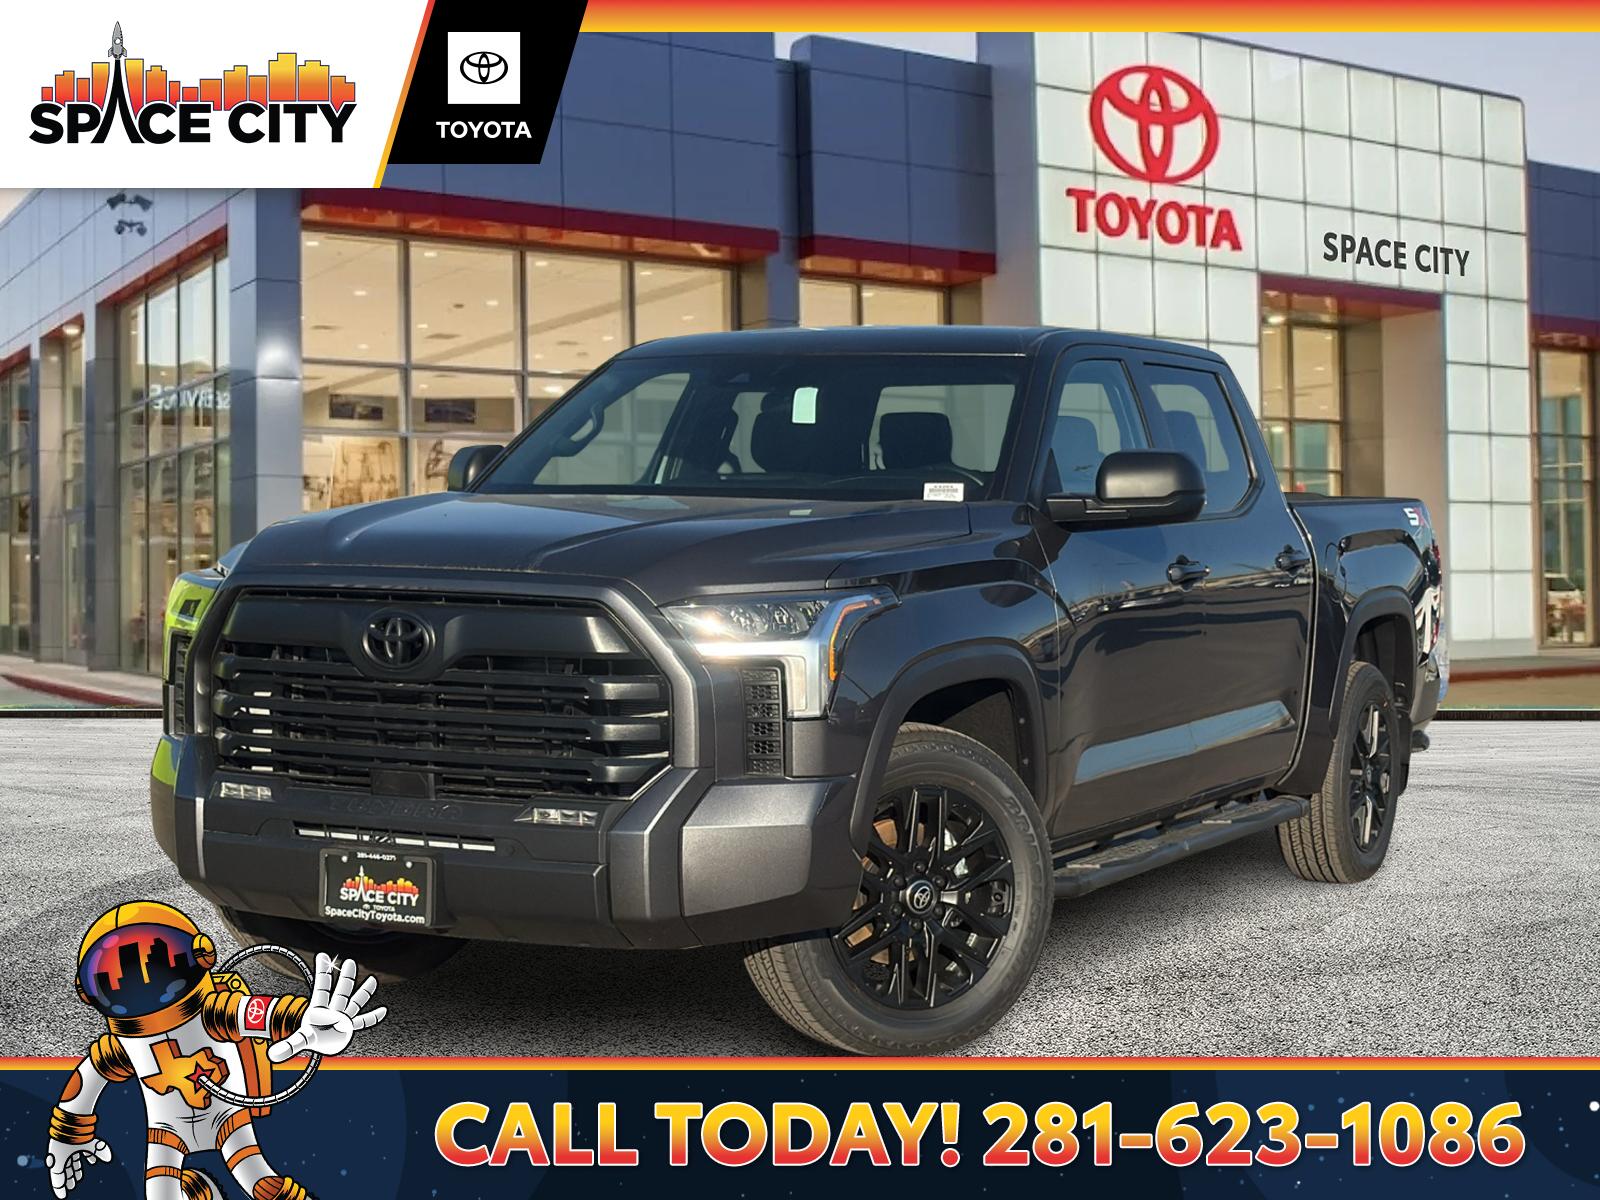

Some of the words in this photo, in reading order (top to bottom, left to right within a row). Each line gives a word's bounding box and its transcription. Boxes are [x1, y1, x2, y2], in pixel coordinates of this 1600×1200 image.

[1065, 186, 1243, 252] TOYOTA
[1322, 231, 1407, 271] SPACE
[1414, 243, 1471, 277] CITY
[340, 885, 385, 904] SPACE
[387, 891, 419, 907] CITY
[324, 905, 426, 925] SpaceCityToyota.com
[373, 904, 396, 912] TOYOTA
